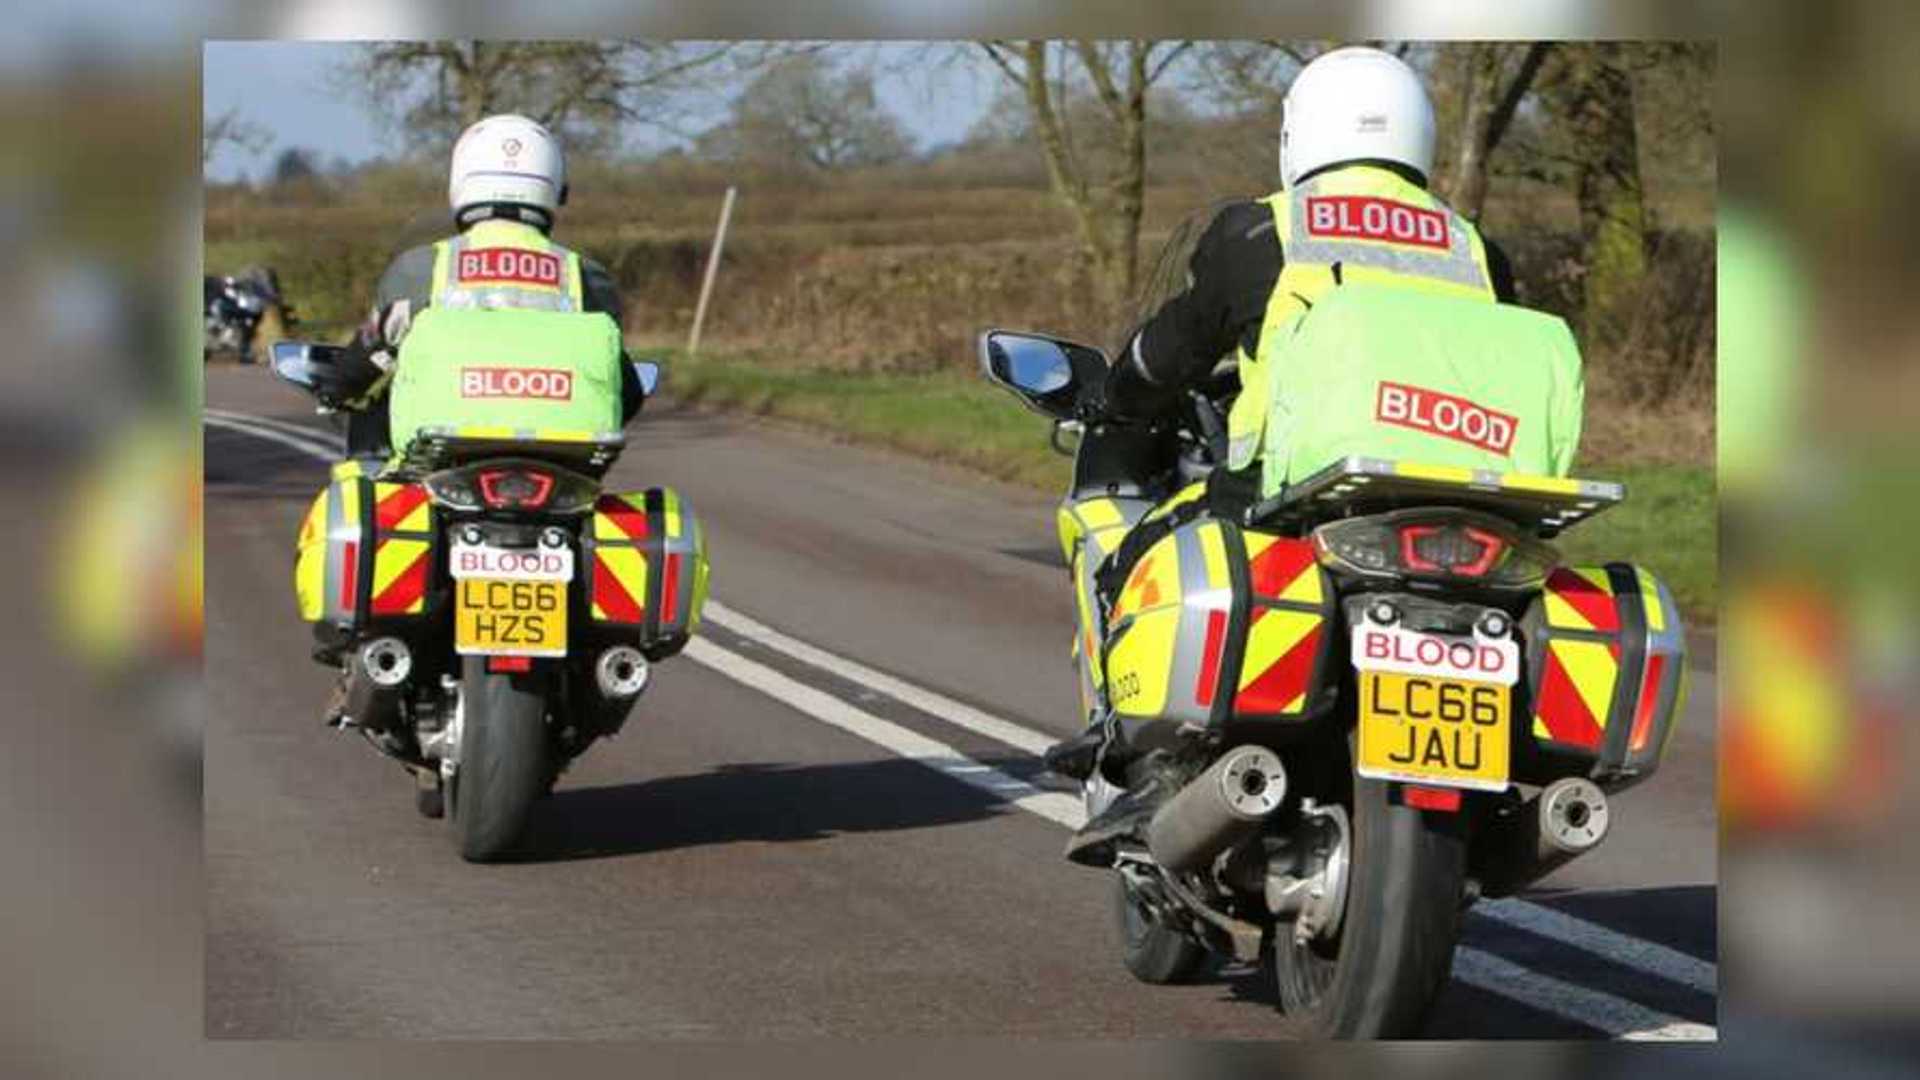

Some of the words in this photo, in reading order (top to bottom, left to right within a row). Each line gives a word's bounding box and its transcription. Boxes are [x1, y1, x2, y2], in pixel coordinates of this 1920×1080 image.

[1312, 203, 1443, 242] BLOOD
[463, 252, 557, 280] BLOOD
[464, 371, 570, 397] BLOOD
[1381, 386, 1511, 449] BLOOD
[461, 552, 564, 573] BLOOD
[464, 580, 558, 612] LC66
[475, 613, 545, 644] HZS
[1365, 632, 1505, 673] BLOOD
[1372, 674, 1499, 726] LC66
[1388, 725, 1482, 770] JAU
